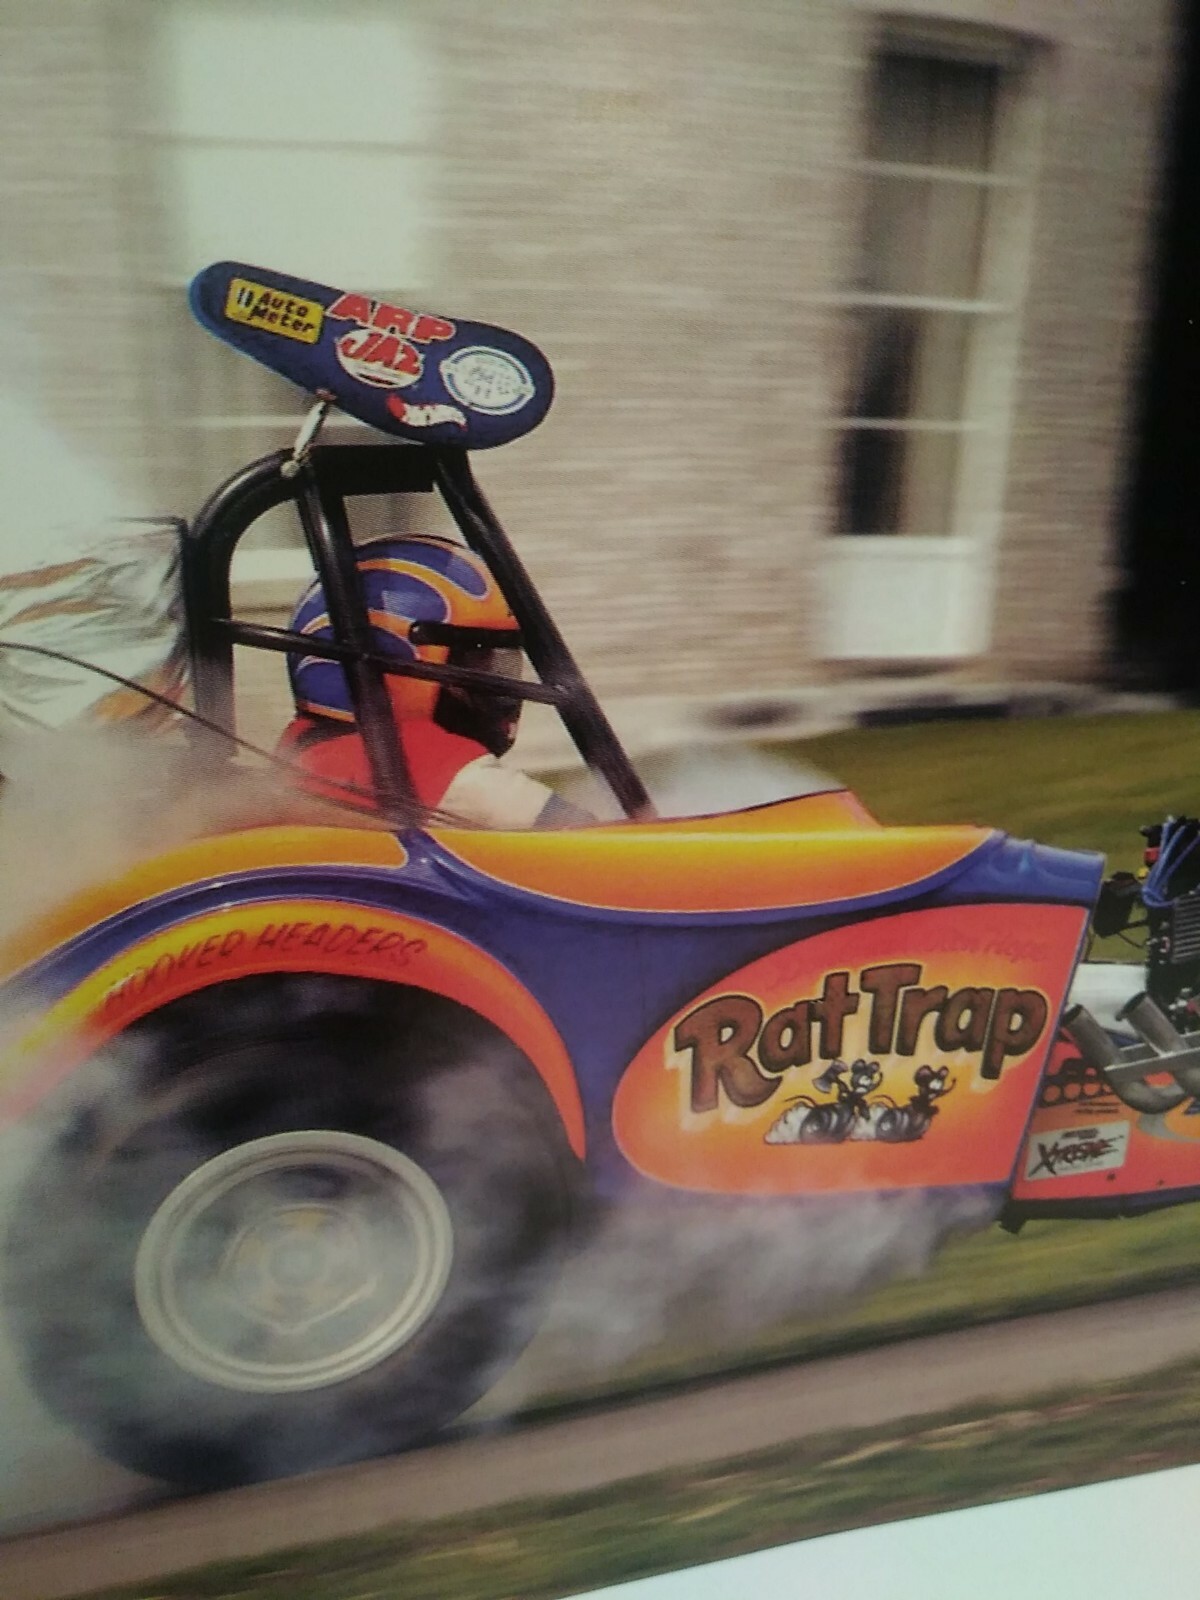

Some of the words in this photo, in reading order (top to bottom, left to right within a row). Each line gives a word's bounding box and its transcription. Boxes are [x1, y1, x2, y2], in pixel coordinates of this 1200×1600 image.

[247, 304, 315, 333] Meter
[259, 290, 309, 317] Auto
[325, 291, 457, 344] ARP
[339, 331, 422, 376] JAZ
[255, 921, 428, 967] HEADERS
[674, 971, 860, 1113] Rat
[859, 963, 1049, 1080] Trap
